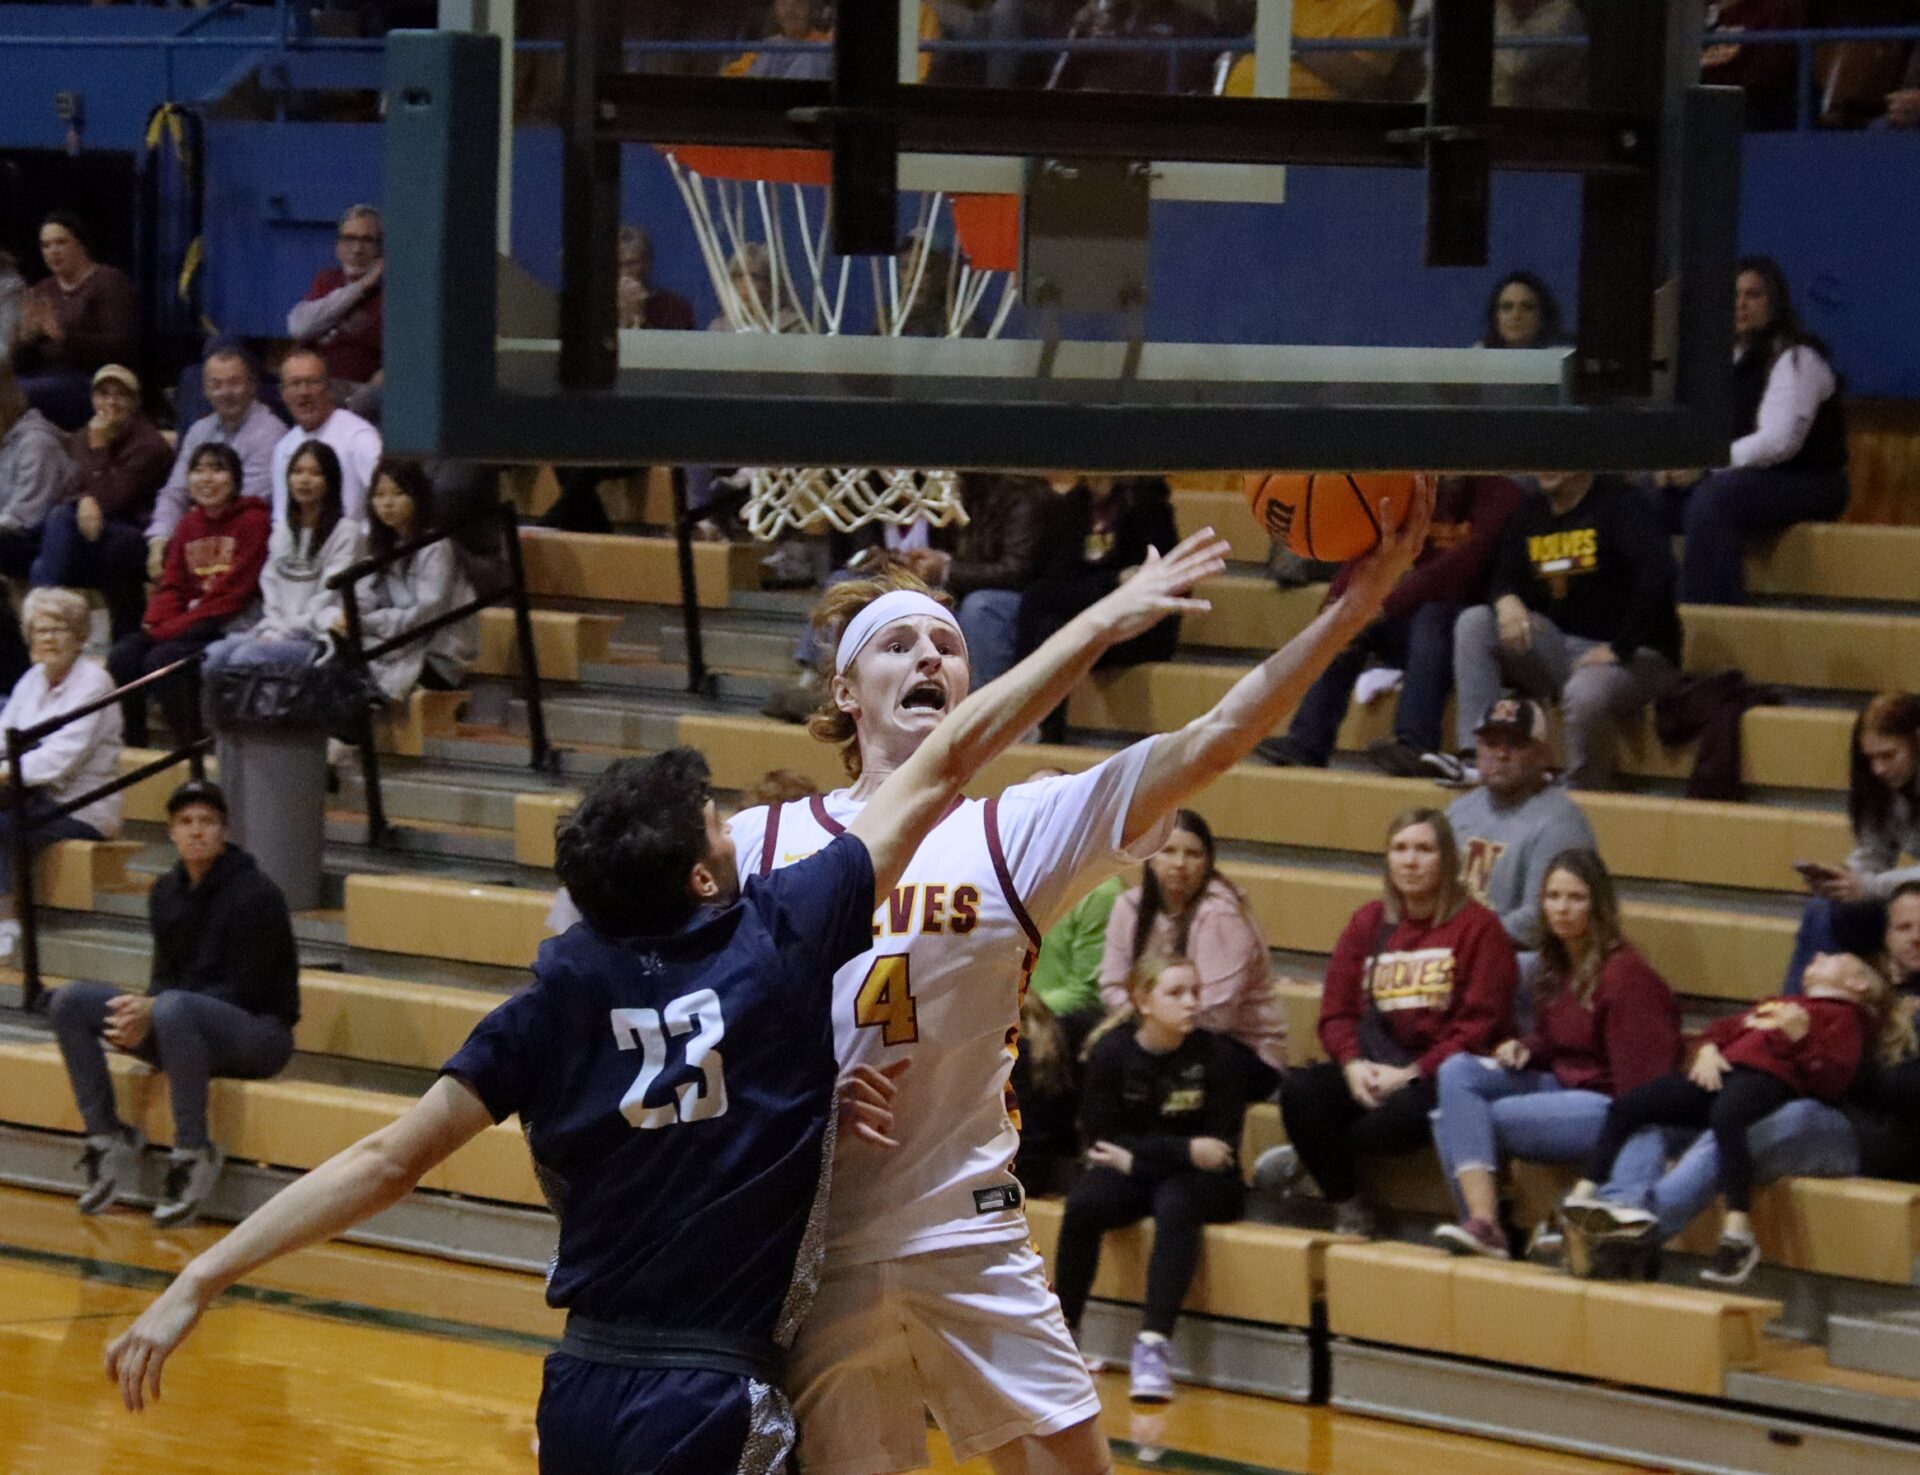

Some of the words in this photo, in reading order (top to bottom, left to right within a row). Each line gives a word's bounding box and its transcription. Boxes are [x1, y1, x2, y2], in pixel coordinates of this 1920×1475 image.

[872, 883, 982, 938] VES
[854, 953, 918, 1047] 4
[611, 988, 728, 1130] 23
